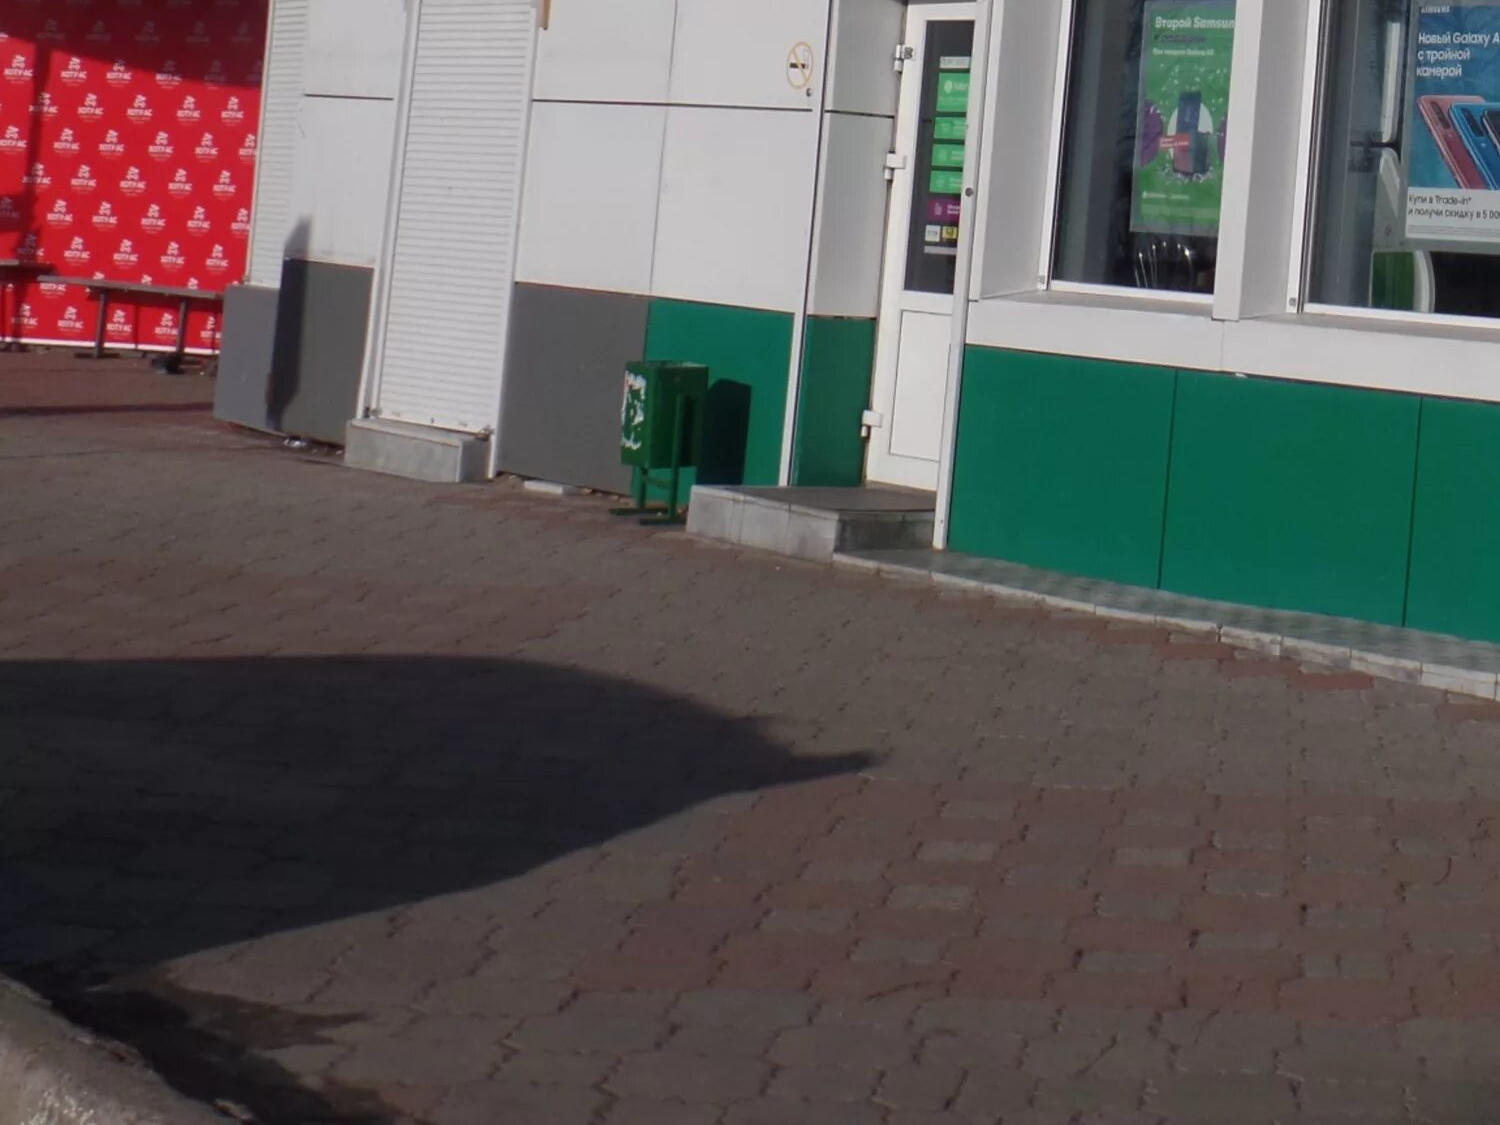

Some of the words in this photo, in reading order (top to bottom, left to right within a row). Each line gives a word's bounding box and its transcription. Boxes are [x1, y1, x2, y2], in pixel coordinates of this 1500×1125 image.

[1418, 31, 1451, 44] Новый
[1452, 32, 1490, 48] Galaxy
[1417, 50, 1425, 60] с
[1426, 48, 1471, 64] тройной
[1416, 64, 1462, 80] камерой
[1415, 208, 1443, 219] получи
[1444, 209, 1475, 221] скидку
